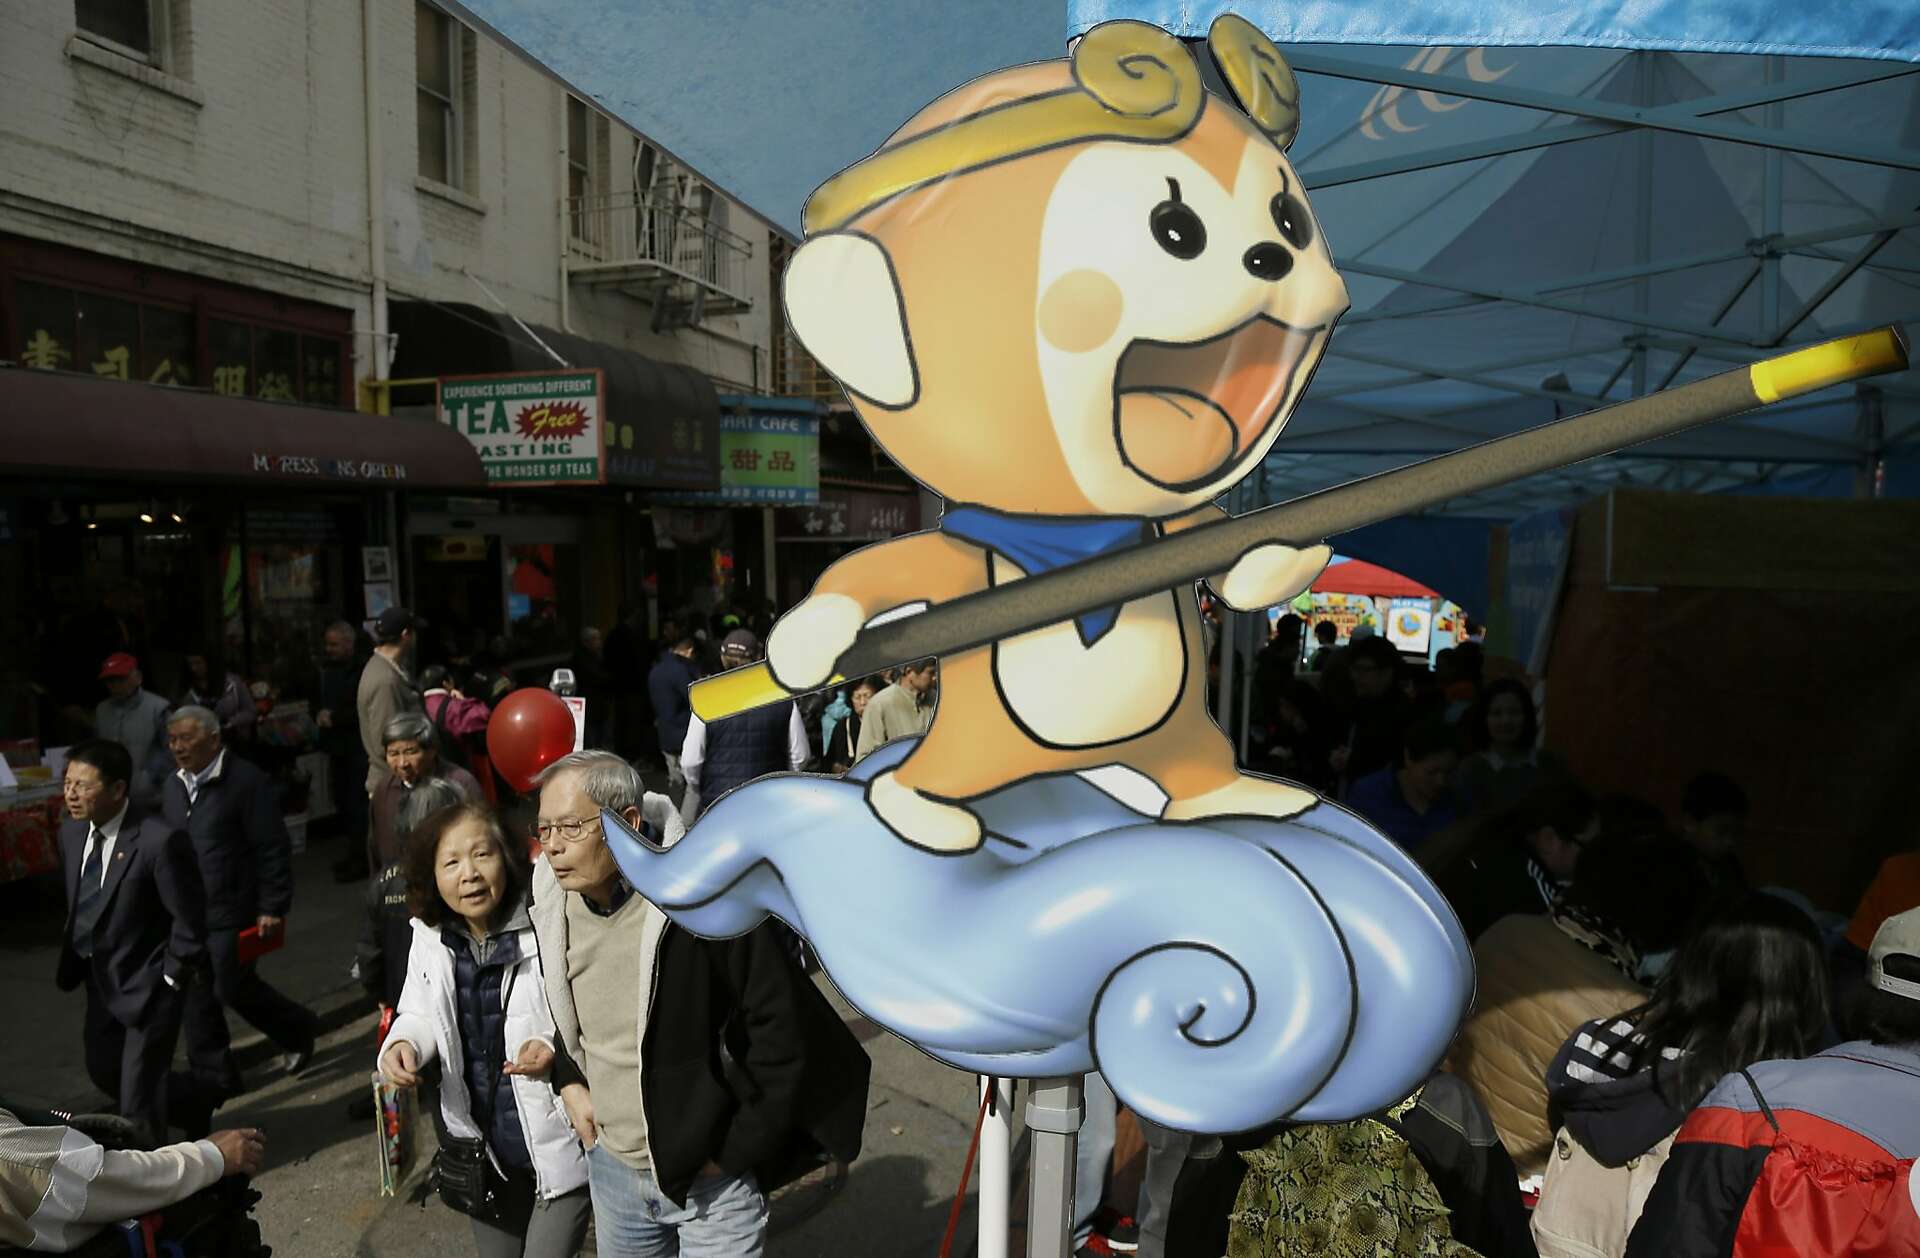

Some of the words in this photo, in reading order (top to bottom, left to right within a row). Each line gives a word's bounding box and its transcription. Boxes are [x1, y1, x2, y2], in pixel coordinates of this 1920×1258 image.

[443, 384, 494, 399] EXPERIENCE
[495, 381, 544, 395] SOMETHING
[545, 379, 592, 393] DIFFERENT
[444, 398, 510, 435] TEA
[529, 408, 579, 434] Free
[759, 416, 800, 431] CAFE
[479, 442, 573, 457] ASTING
[729, 448, 796, 472] 甜品
[504, 464, 546, 478] WONDER
[549, 463, 562, 476] OF
[566, 462, 592, 475] TEAS
